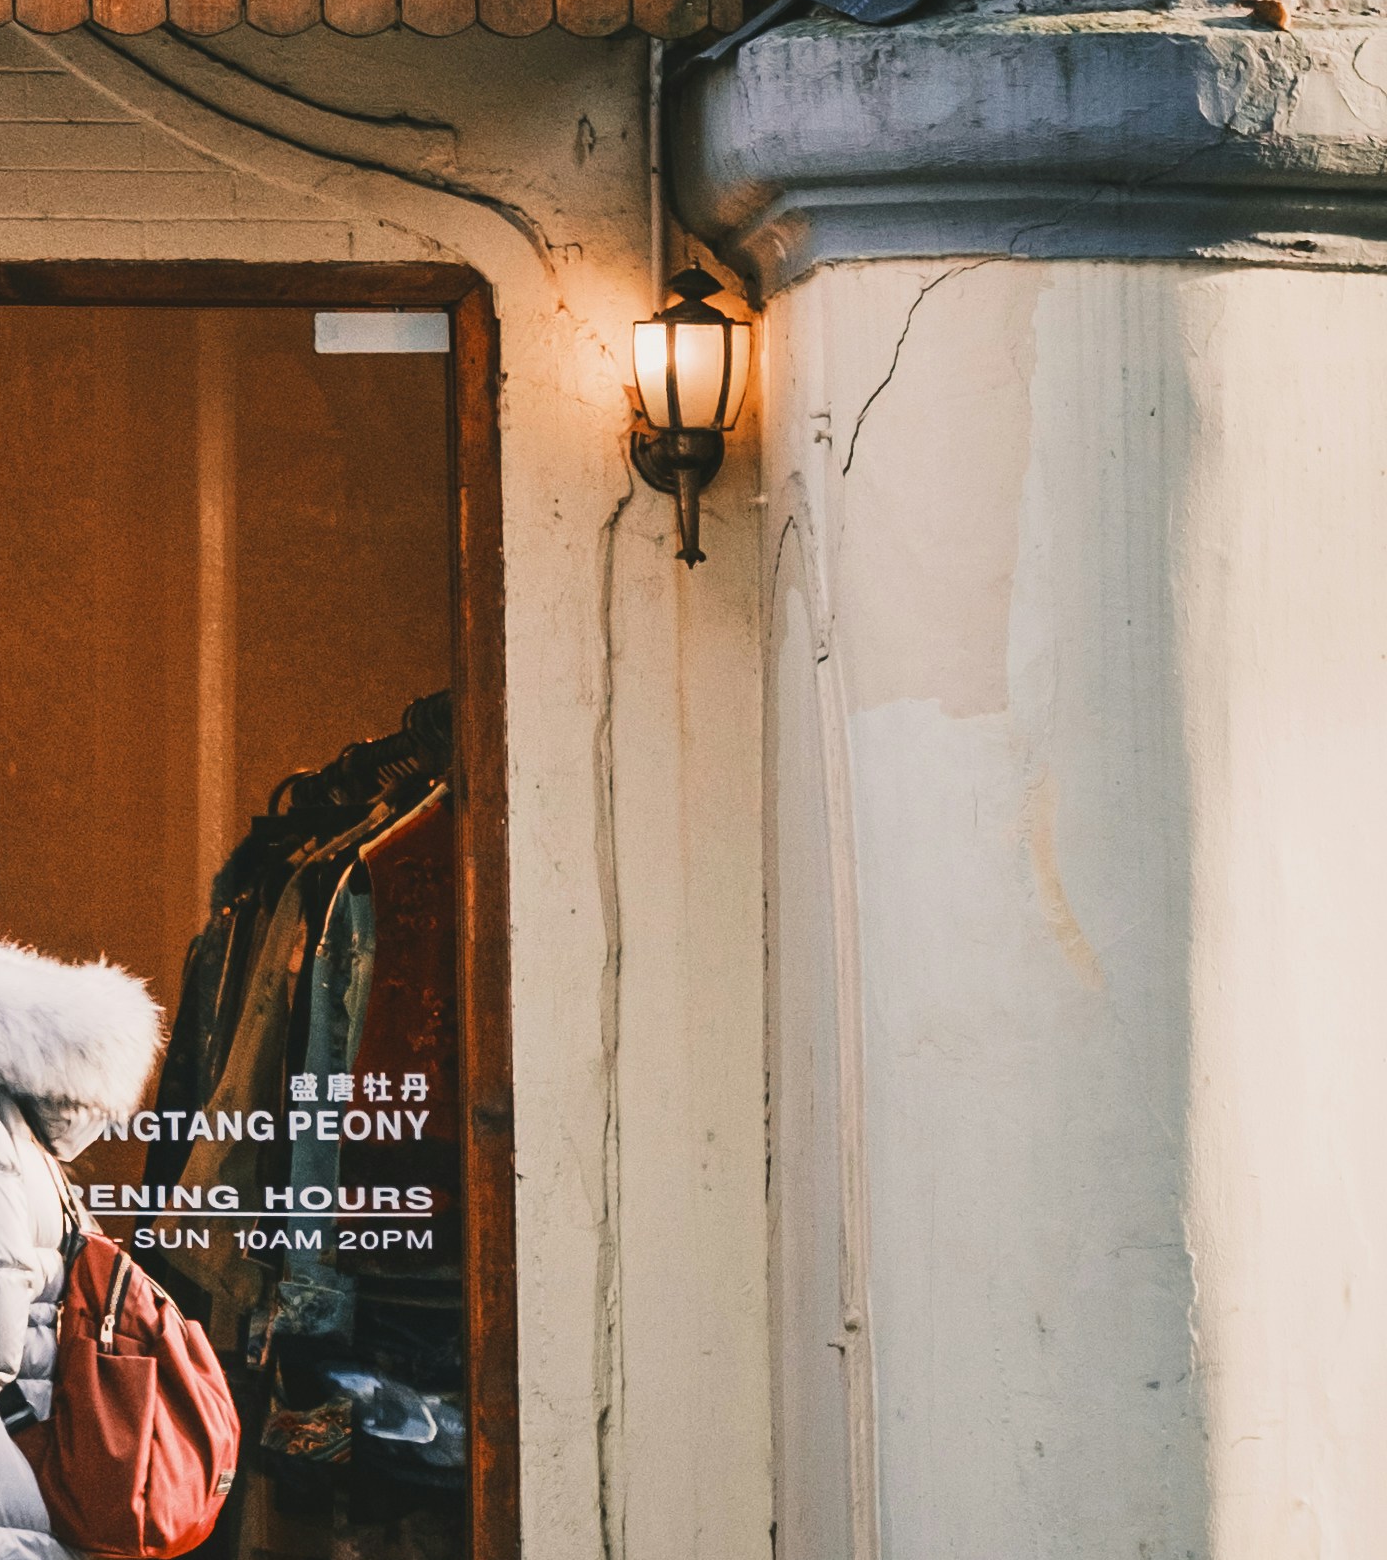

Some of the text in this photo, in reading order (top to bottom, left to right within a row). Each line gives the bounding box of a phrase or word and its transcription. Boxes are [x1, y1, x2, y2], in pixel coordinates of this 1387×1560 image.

[289, 1071, 430, 1102] 盛唐牡丹
[288, 1110, 430, 1141] PEONY
[264, 1185, 434, 1211] HOURS
[133, 1228, 210, 1250] SUN
[233, 1229, 323, 1251] 10AM
[338, 1229, 434, 1251] 20PM
